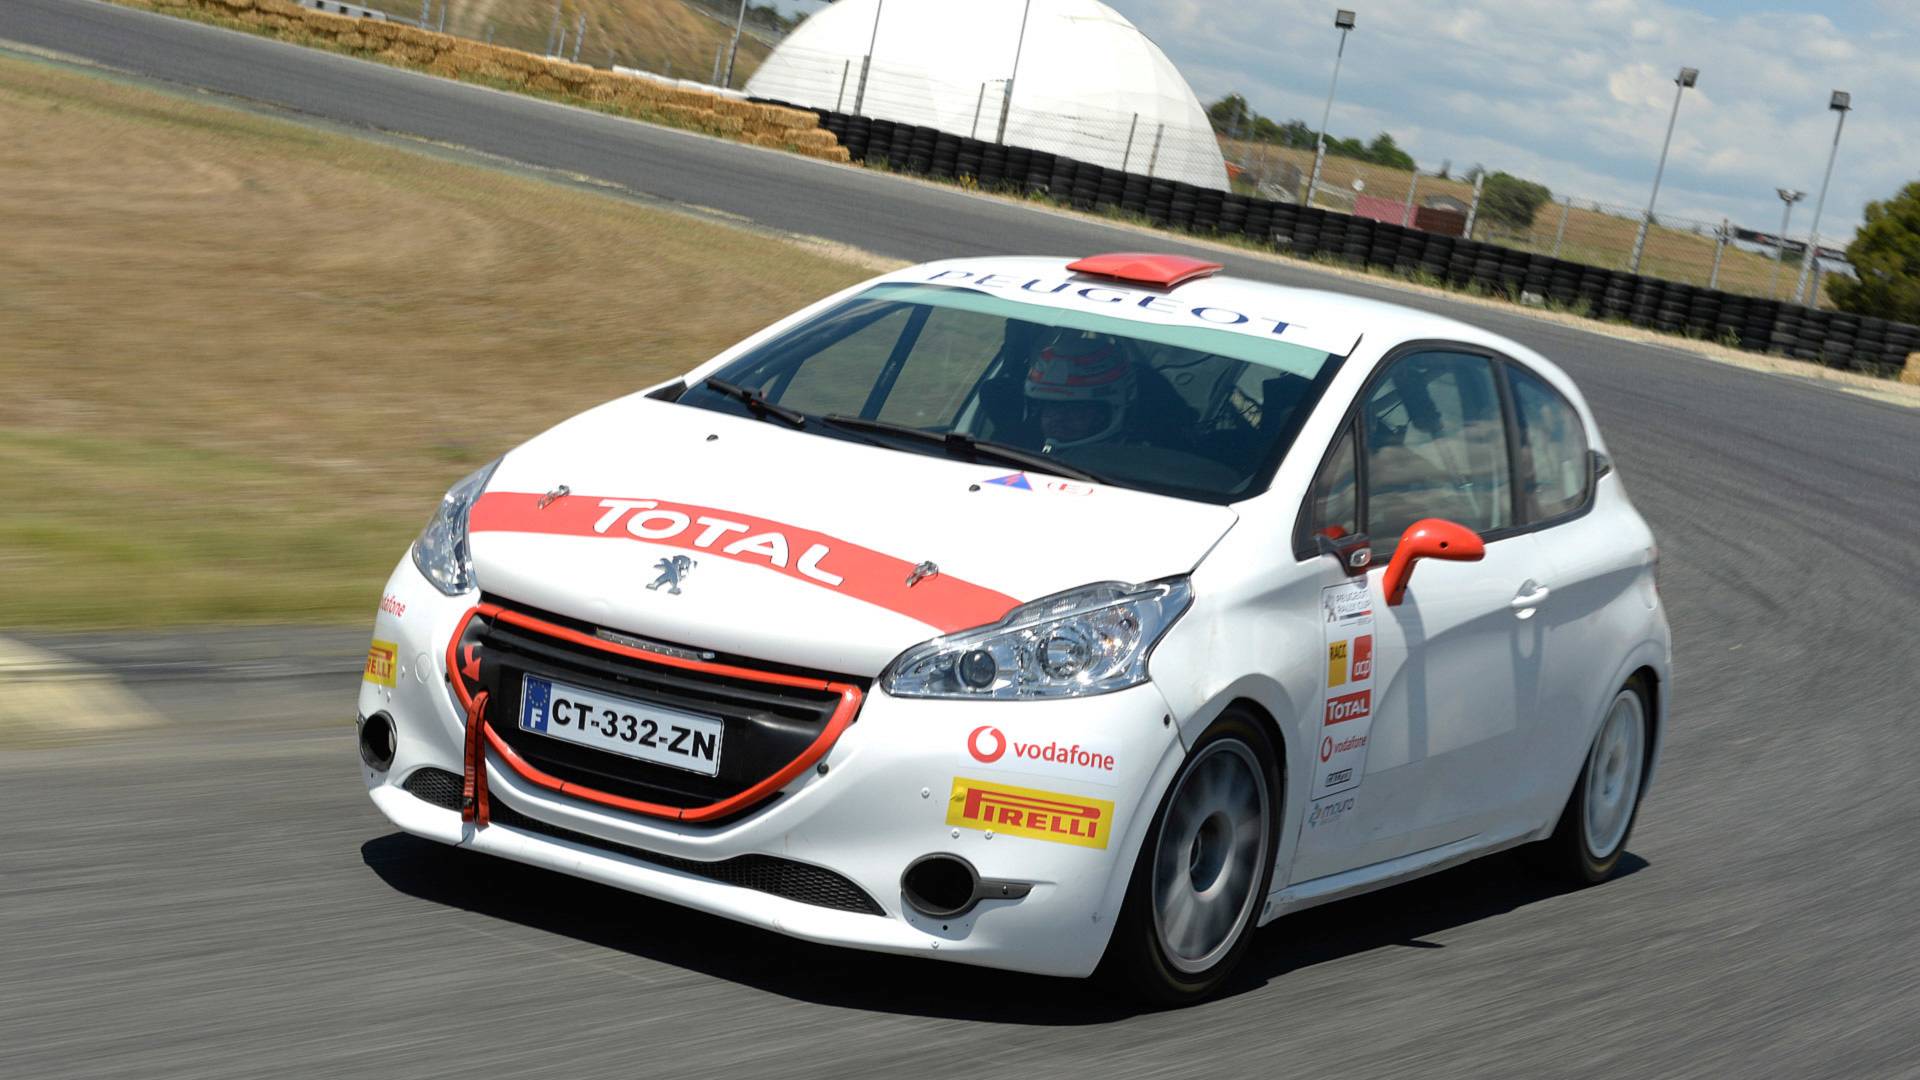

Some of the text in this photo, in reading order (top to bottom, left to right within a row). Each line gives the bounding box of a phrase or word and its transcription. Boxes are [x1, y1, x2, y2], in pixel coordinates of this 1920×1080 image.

[929, 269, 1308, 334] PEUGEOT
[593, 499, 844, 586] TOTAL
[531, 710, 543, 728] F
[1328, 698, 1369, 720] TOTAL
[552, 699, 717, 761] CT-332-ZN
[1335, 735, 1367, 753] vodafone
[1014, 741, 1114, 771] vodafone
[963, 788, 1101, 838] PIRELLI
